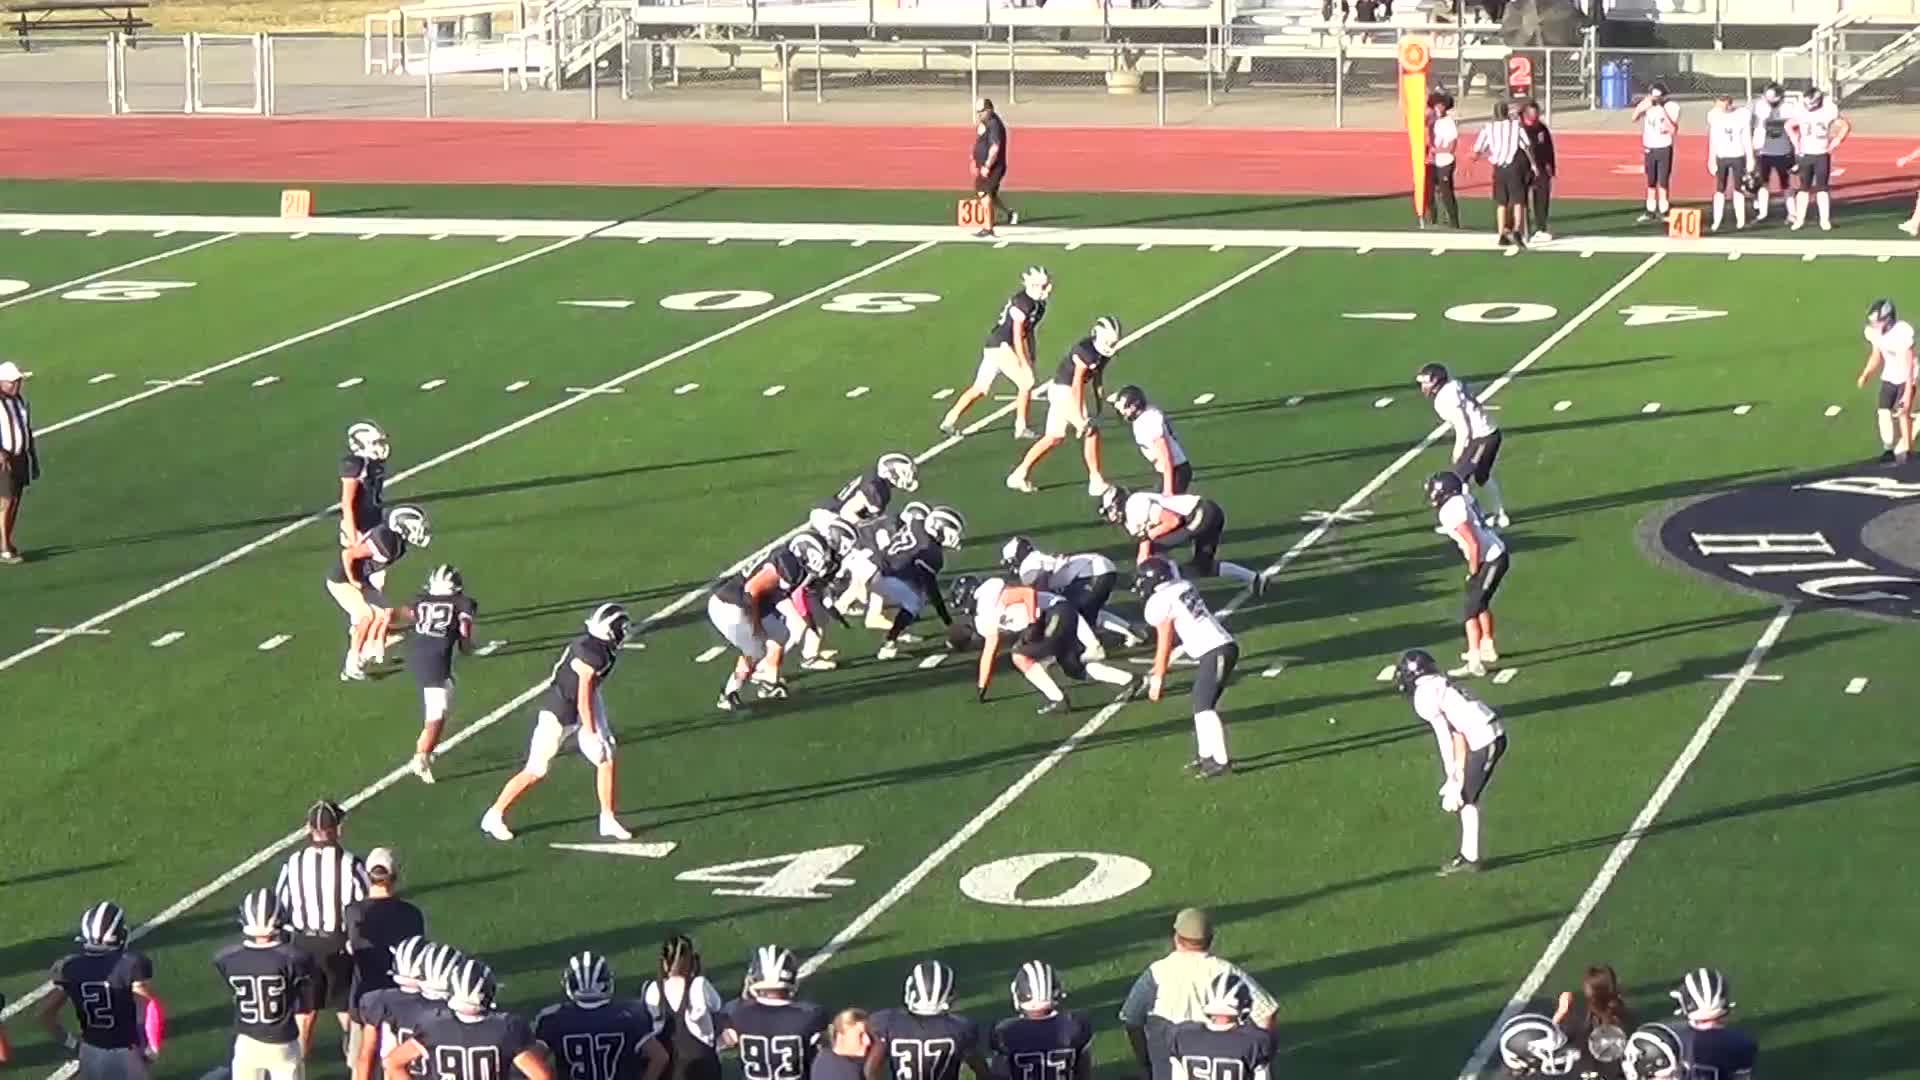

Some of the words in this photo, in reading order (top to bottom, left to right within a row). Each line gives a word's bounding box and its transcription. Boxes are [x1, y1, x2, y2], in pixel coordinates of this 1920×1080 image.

[1509, 57, 1532, 86] 2
[962, 201, 985, 225] 30
[1673, 210, 1697, 235] 40
[415, 601, 454, 638] 12
[80, 981, 115, 1030] 2
[229, 975, 286, 1024] 26
[436, 1045, 499, 1080] 90
[562, 1031, 626, 1080] 97
[739, 1034, 805, 1080] 93
[891, 1038, 955, 1080] 37
